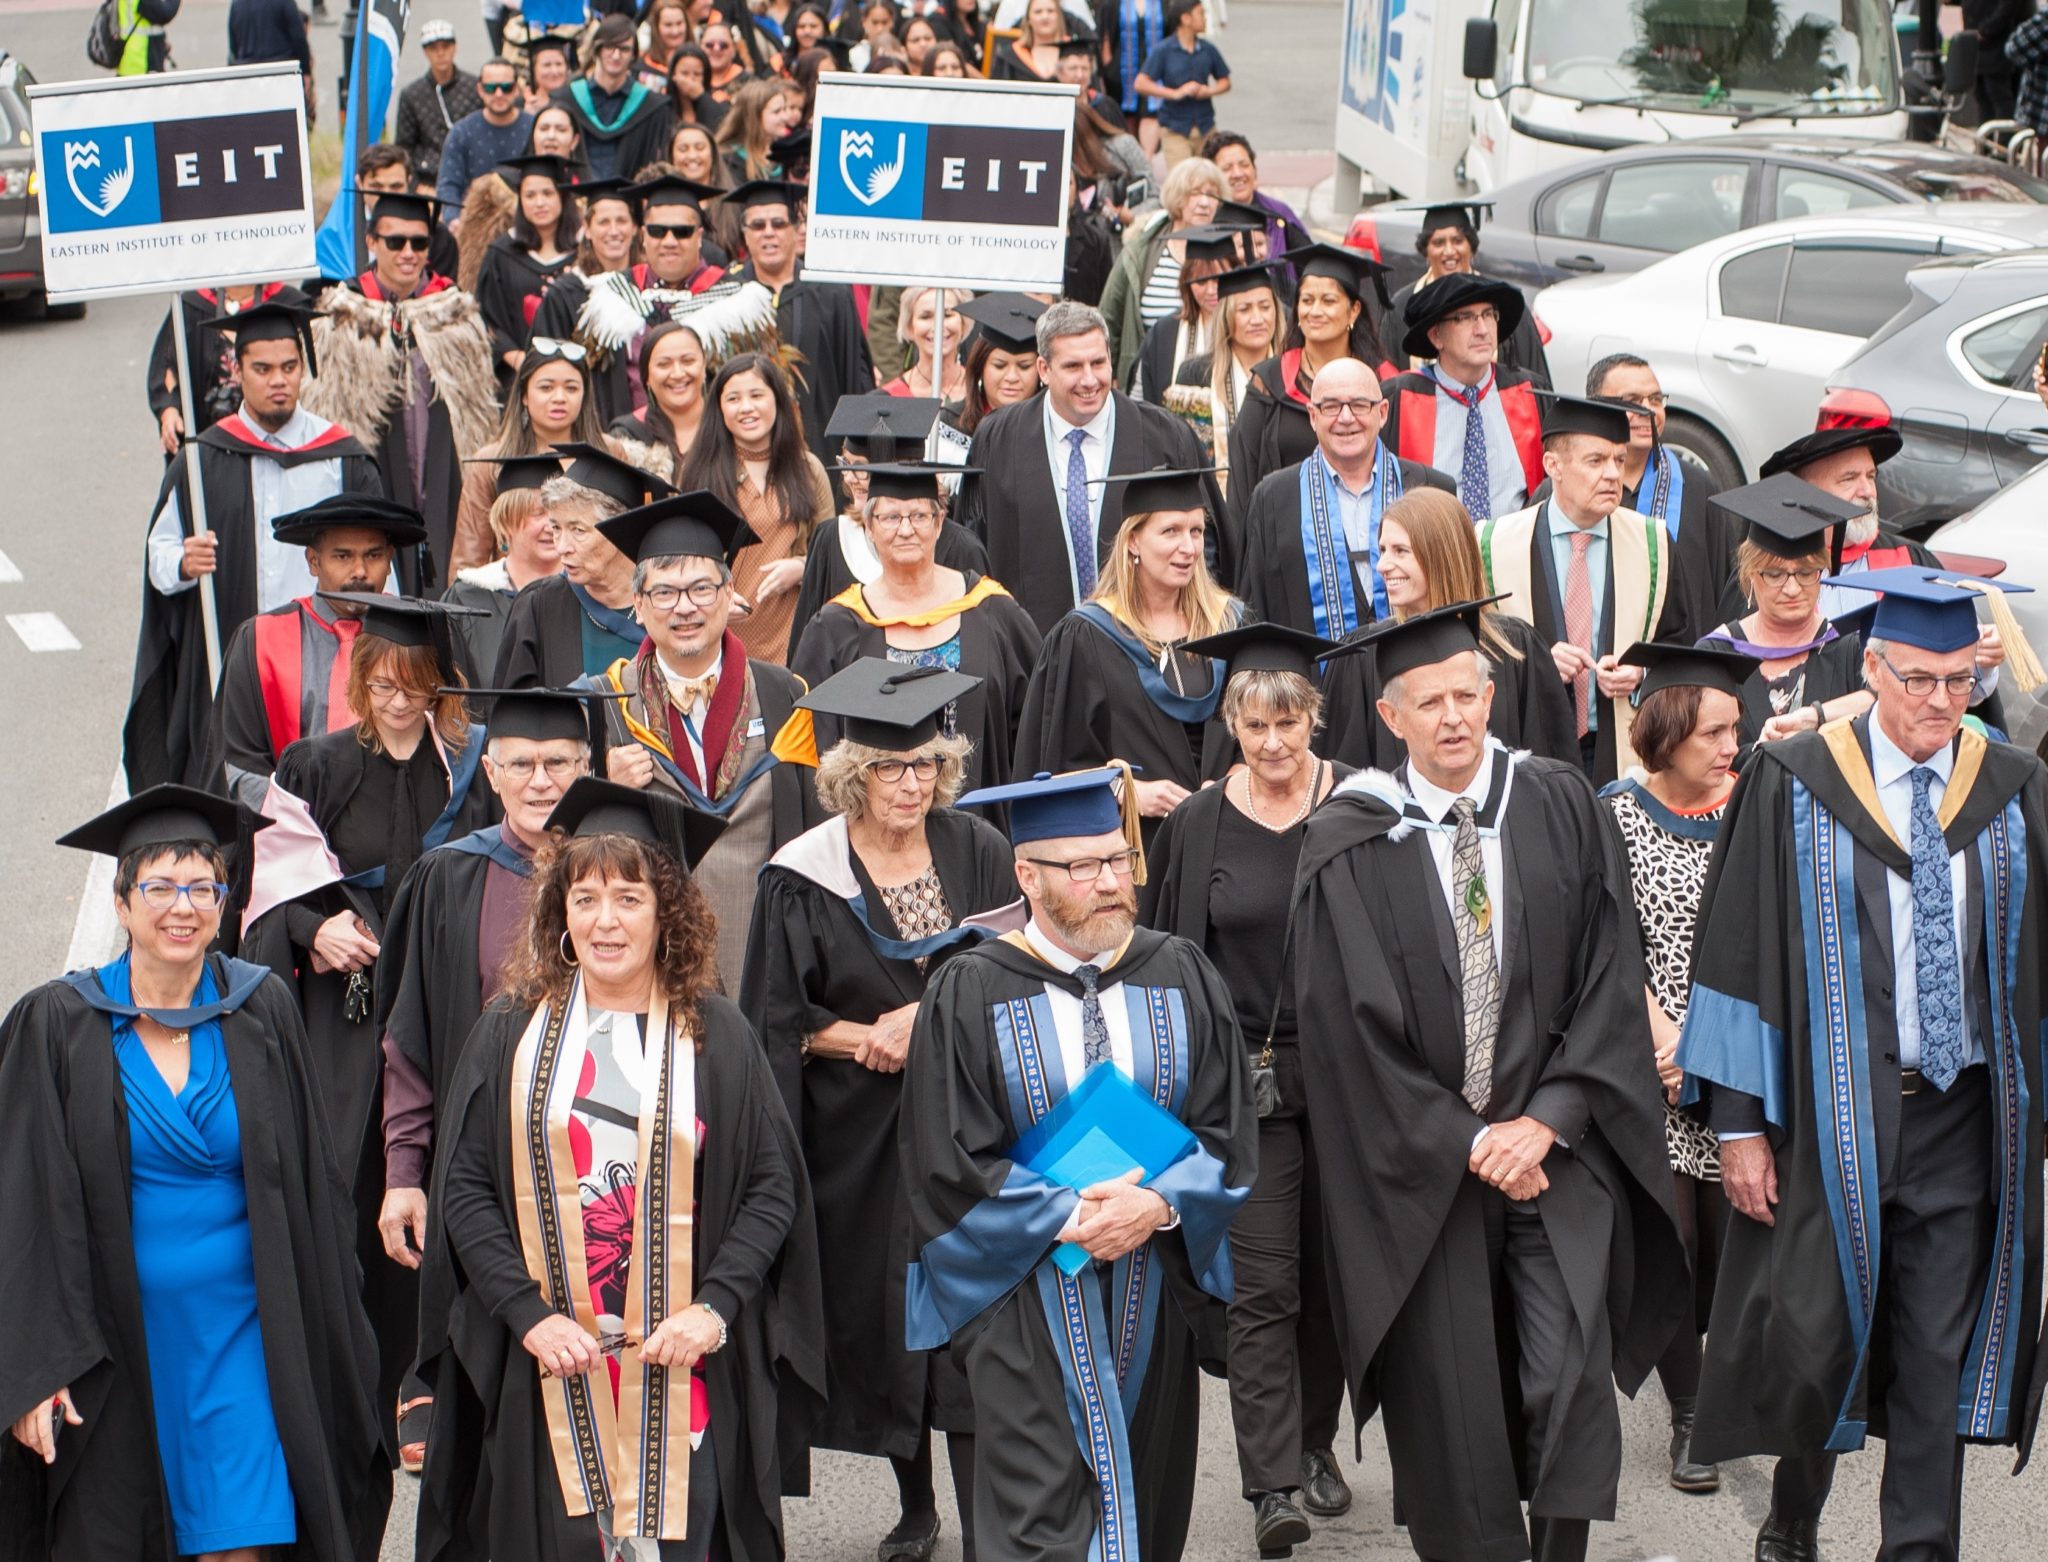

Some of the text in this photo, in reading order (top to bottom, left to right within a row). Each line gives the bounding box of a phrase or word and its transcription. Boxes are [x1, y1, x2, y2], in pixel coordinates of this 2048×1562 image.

[174, 144, 284, 188] EIT
[941, 156, 1048, 194] EIT
[50, 223, 307, 259] EASTERN INSTITUTE OF TECHNOLOGY
[813, 227, 1059, 251] EASTERN INSTITUTE OF TECHNOLOGY
